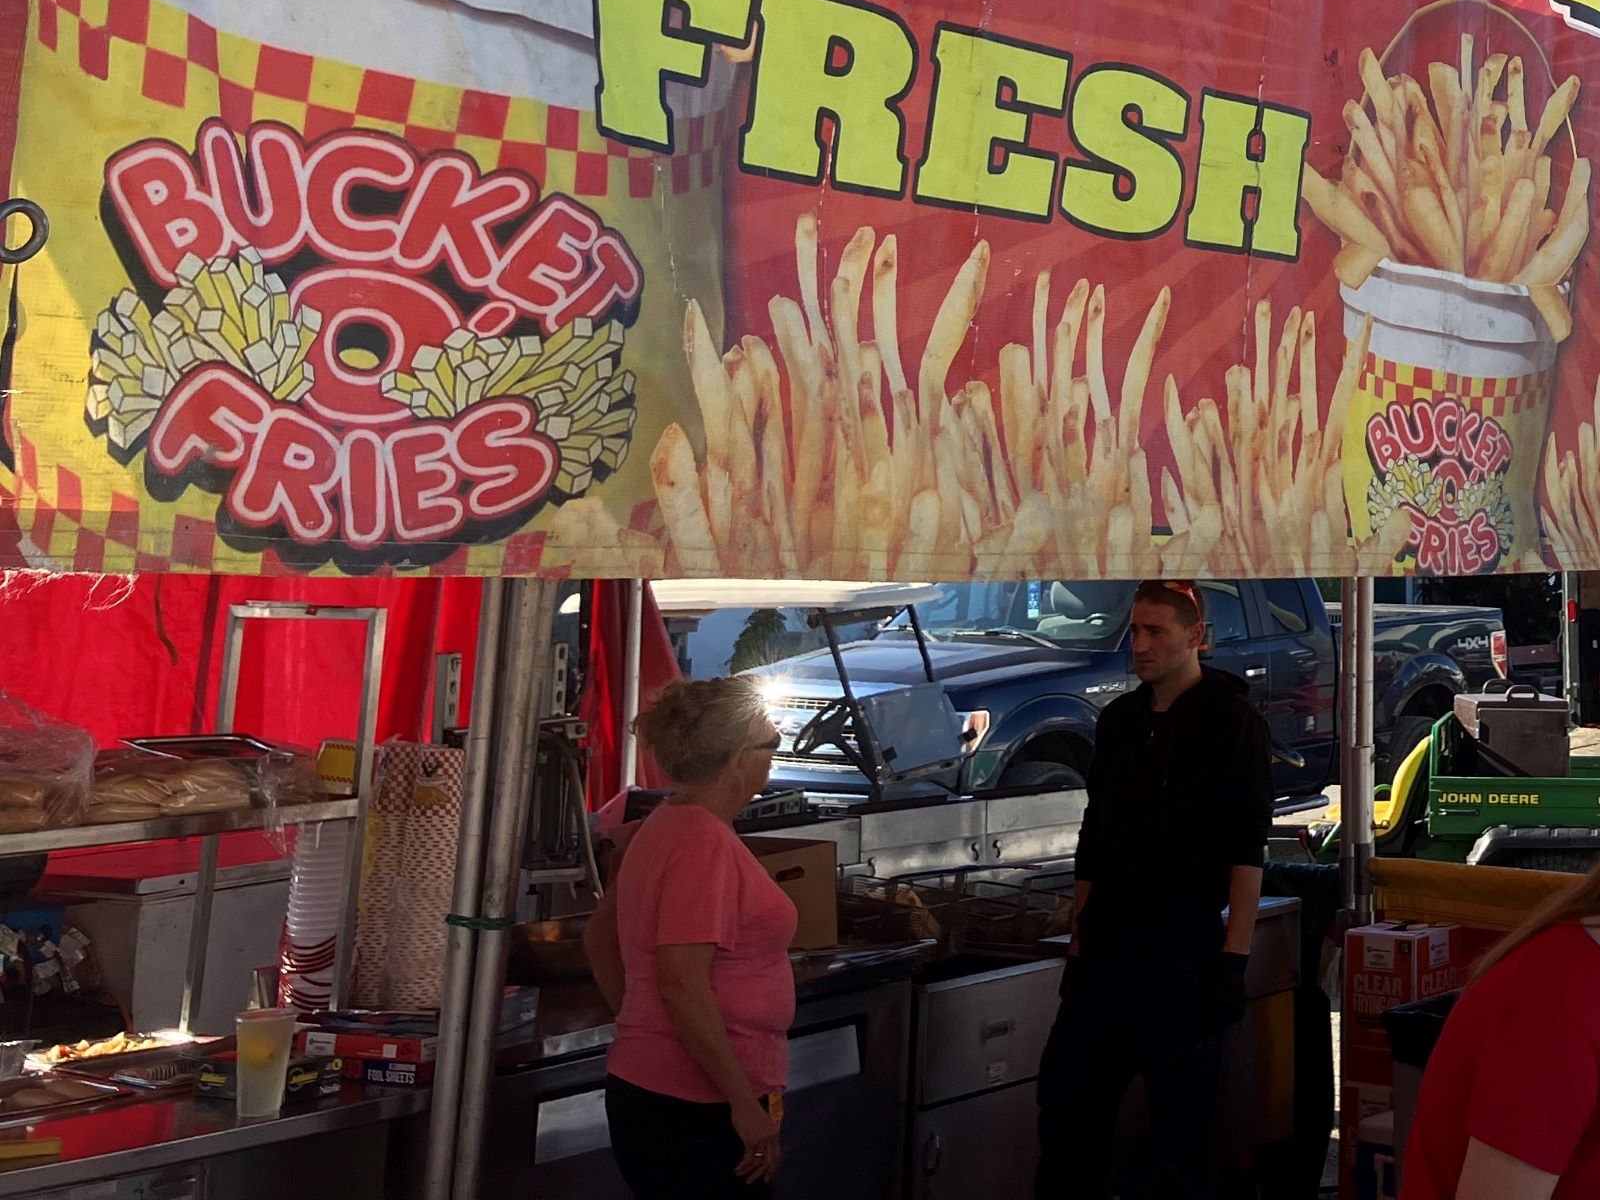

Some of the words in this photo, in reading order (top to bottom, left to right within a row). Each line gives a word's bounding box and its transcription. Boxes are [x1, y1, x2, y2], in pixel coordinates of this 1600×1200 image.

[103, 118, 642, 341] BUCKET
[150, 365, 560, 546] FRIES
[1367, 398, 1513, 482] BUCKET
[1438, 792, 1482, 804] JOHN
[1488, 793, 1539, 805] DEERE
[1353, 972, 1404, 995] CLEAR
[385, 1070, 416, 1085] SHEETS
